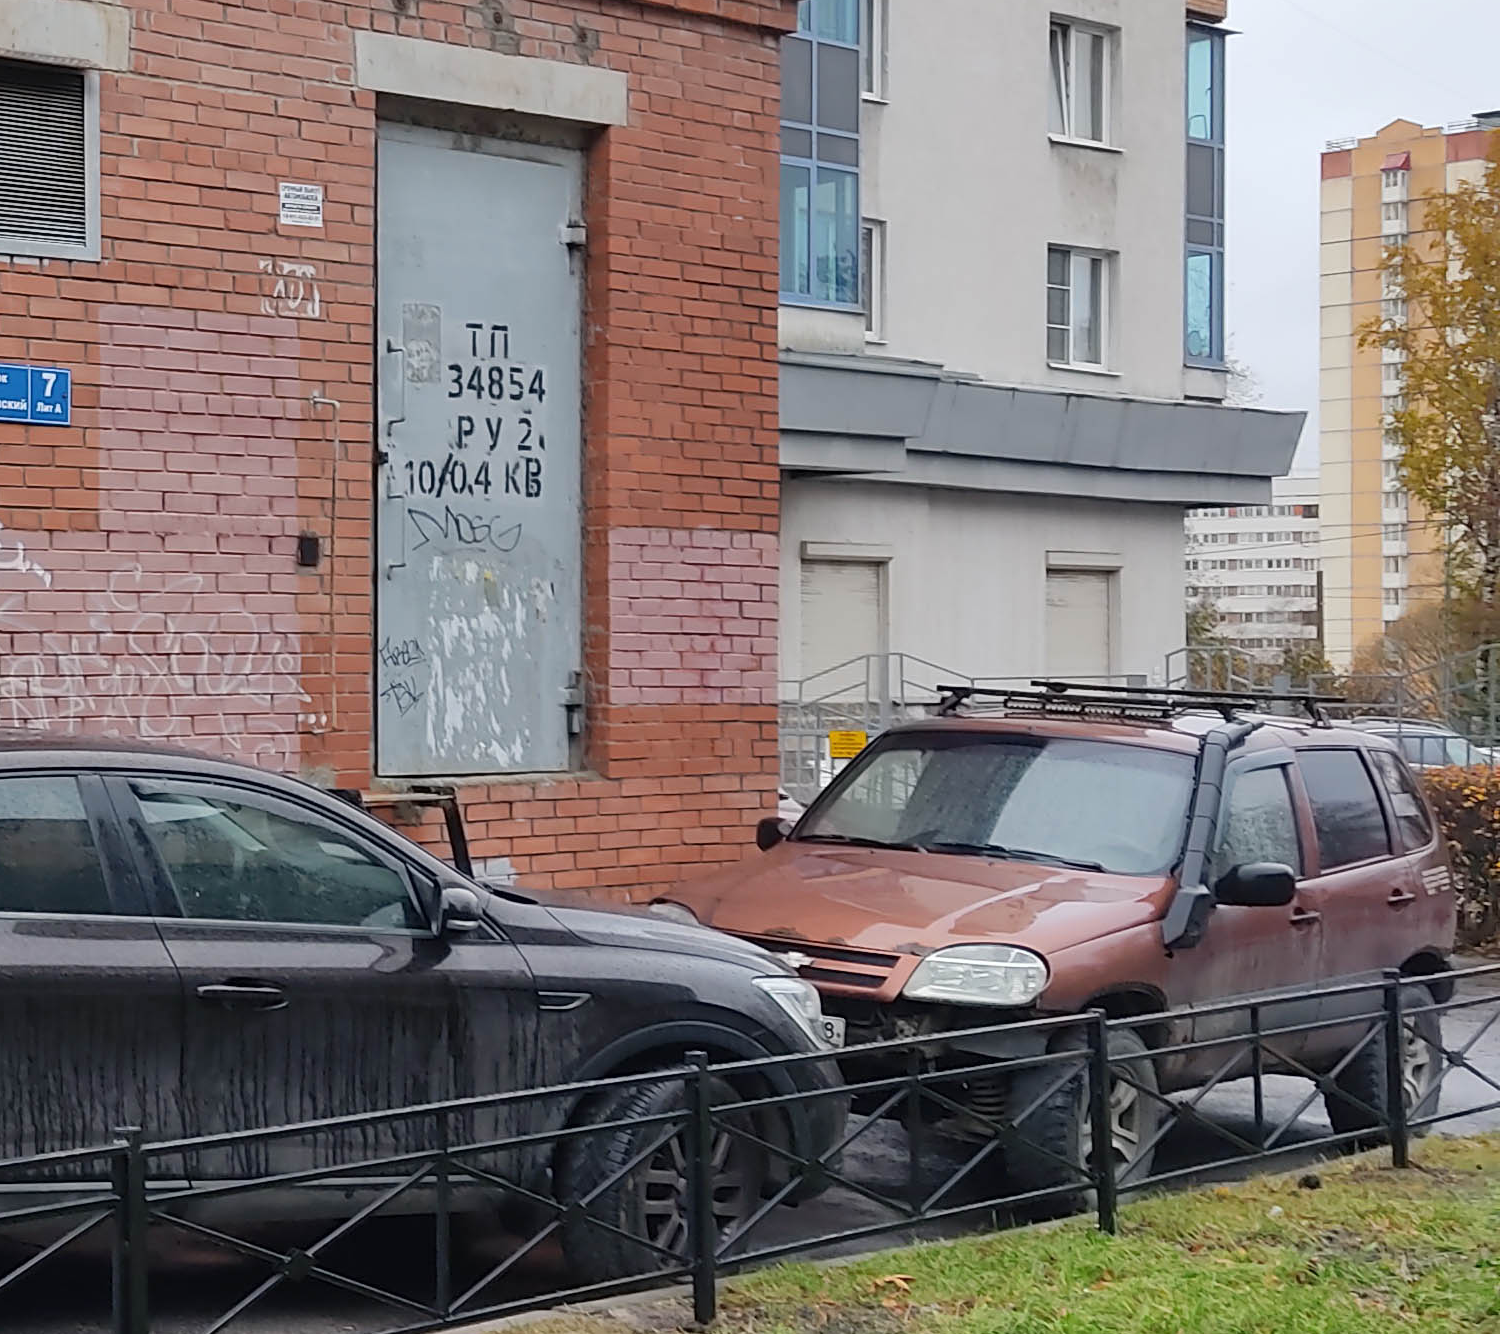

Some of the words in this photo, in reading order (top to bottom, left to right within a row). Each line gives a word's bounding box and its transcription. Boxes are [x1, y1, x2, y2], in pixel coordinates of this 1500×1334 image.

[465, 323, 509, 359] ТП
[42, 372, 57, 397] 7
[447, 364, 546, 403] 34854
[54, 403, 63, 414] А
